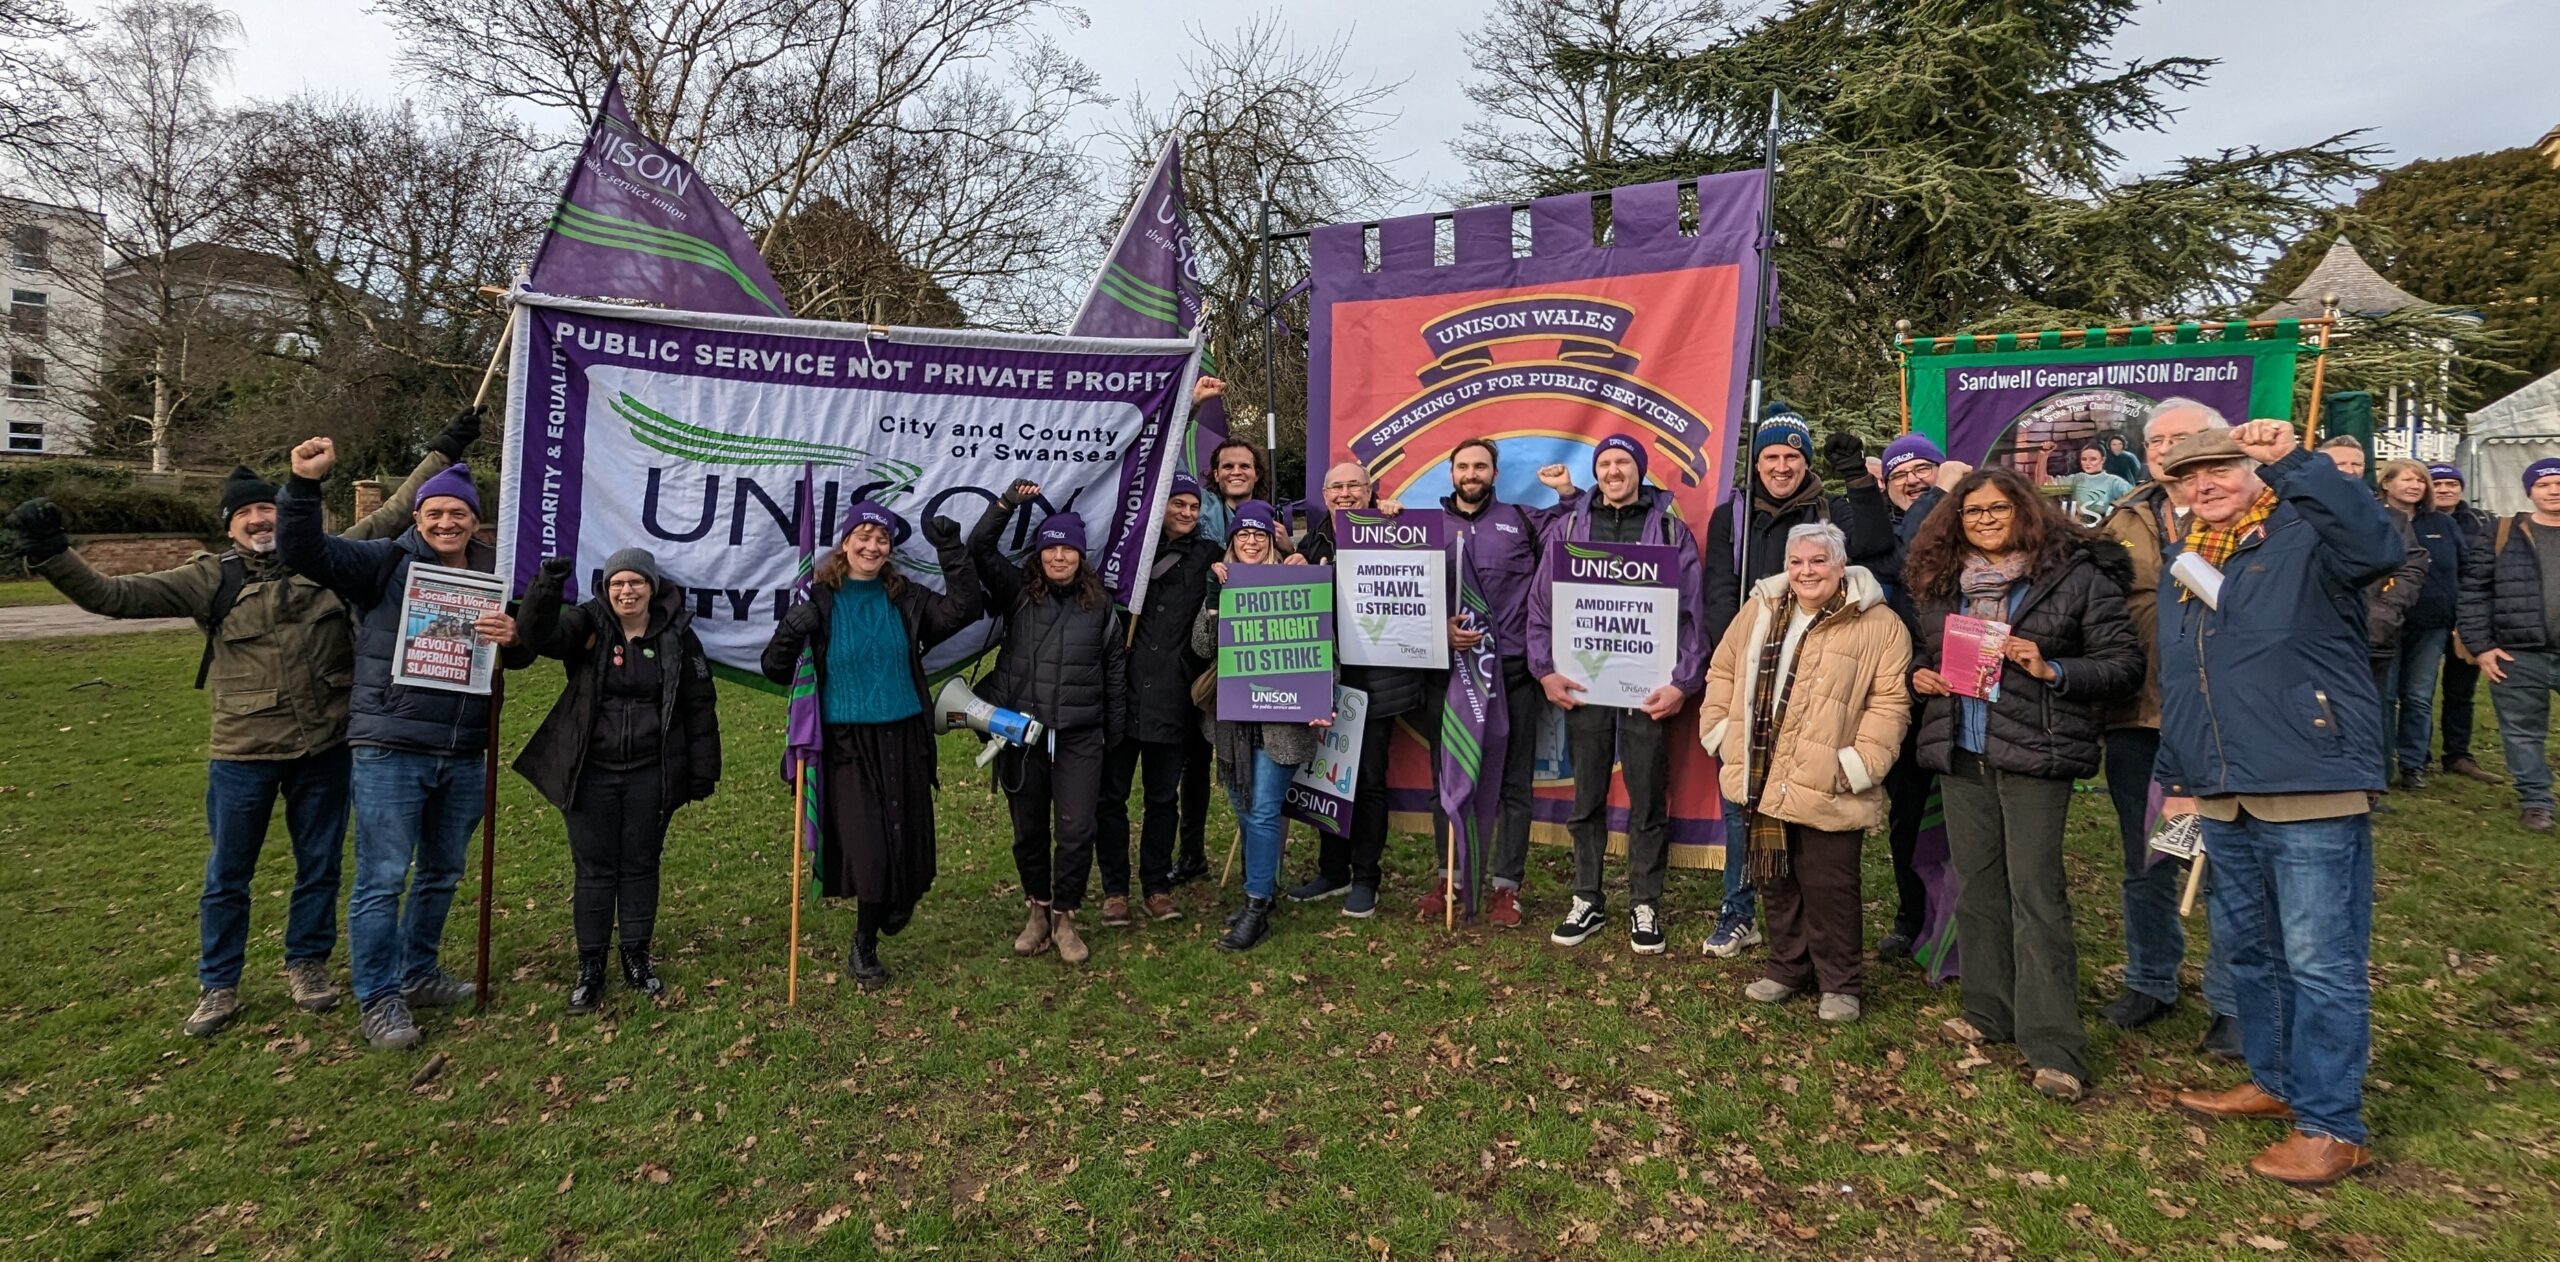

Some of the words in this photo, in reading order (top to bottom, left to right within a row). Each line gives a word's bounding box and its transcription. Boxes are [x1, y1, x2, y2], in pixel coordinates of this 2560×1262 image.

[607, 174, 650, 200] service
[651, 196, 688, 220] union
[1145, 227, 1163, 244] the
[1436, 310, 1527, 345] UNISON
[1531, 309, 1617, 333] WALES
[555, 321, 680, 363] PUBLIC
[695, 343, 836, 377] SERVICE
[847, 356, 913, 381] NOT
[923, 362, 1054, 391] PRIVATE
[1064, 370, 1173, 393] PROFIT
[1958, 369, 2032, 391] Sandwell
[2035, 367, 2103, 388] General
[2107, 363, 2170, 385] UNISON
[2173, 361, 2238, 382] Branch
[547, 335, 569, 440] EQUALITY
[1371, 393, 1456, 446] SPEAKING
[1457, 382, 1483, 399] UP
[1486, 373, 1525, 392] FOR
[1529, 373, 1598, 393] PUBLIC
[1600, 384, 1689, 433] SERVICES
[2043, 408, 2067, 423] Broke
[2067, 403, 2087, 414] Their
[879, 415, 937, 439] City
[952, 422, 1003, 439] and
[1018, 422, 1119, 446] County
[2019, 417, 2034, 429] The
[547, 445, 562, 460] &
[951, 443, 979, 458] of
[994, 443, 1118, 463] Swansea
[540, 463, 563, 567] LIDARITY
[1351, 525, 1427, 544] UNISON
[1356, 564, 1425, 577] AMDDIFFYN
[1571, 558, 1658, 581] UNISON
[1359, 584, 1372, 594] YR
[1373, 580, 1425, 598] HAWL
[418, 589, 463, 605] Socialist
[463, 594, 500, 610] Worker
[1235, 588, 1312, 614] PROTECT
[1365, 602, 1427, 616] STREICIO
[1575, 598, 1653, 613] AMDDIFFYN
[1231, 619, 1264, 643] THE
[1267, 616, 1320, 643] RIGHT
[1578, 618, 1592, 629] YR
[1594, 616, 1651, 635] HAWL
[414, 636, 454, 653] REVOLT
[453, 643, 466, 655] AT
[1584, 637, 1654, 655] STREICIO
[407, 648, 471, 668] IMPERIALIST
[1233, 650, 1256, 673] TO
[1260, 645, 1323, 671] STRIKE
[407, 661, 467, 681] SLAUGHTER
[1455, 649, 1471, 685] ervice
[1466, 688, 1485, 723] union
[1251, 691, 1298, 704] UNISON
[1285, 787, 1339, 819] UNISO
